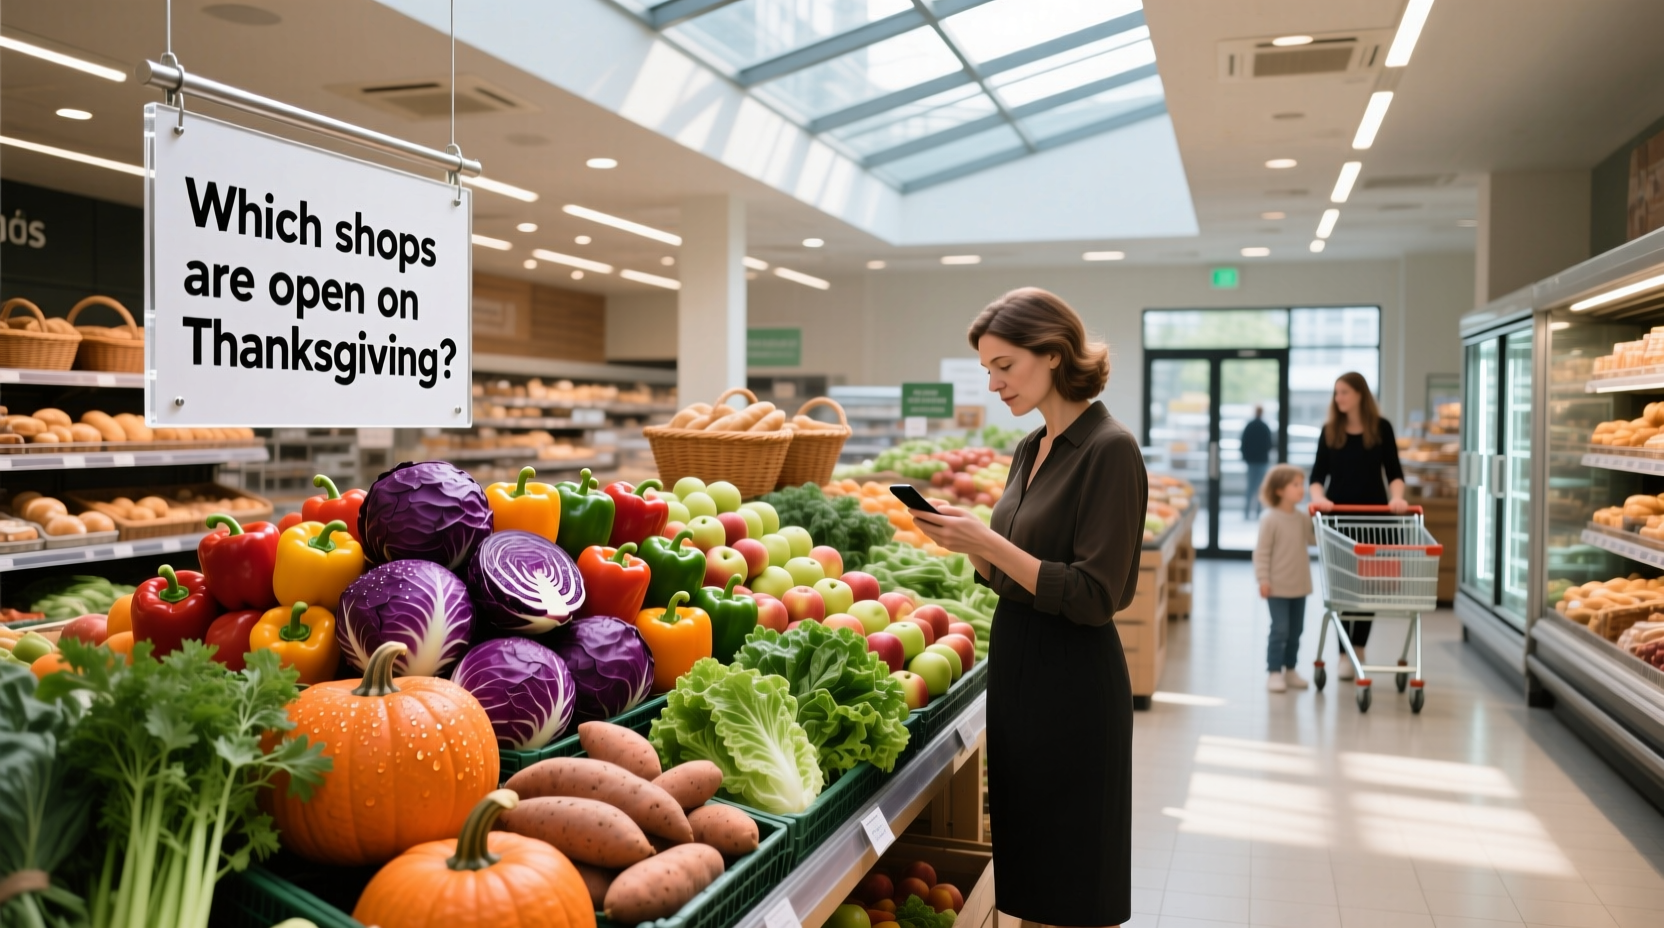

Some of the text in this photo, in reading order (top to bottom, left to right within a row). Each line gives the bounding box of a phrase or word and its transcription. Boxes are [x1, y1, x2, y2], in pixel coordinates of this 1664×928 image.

[185, 177, 437, 273] Which shops
[184, 261, 418, 320] are open on
[183, 317, 457, 389] Thanksgiving?
